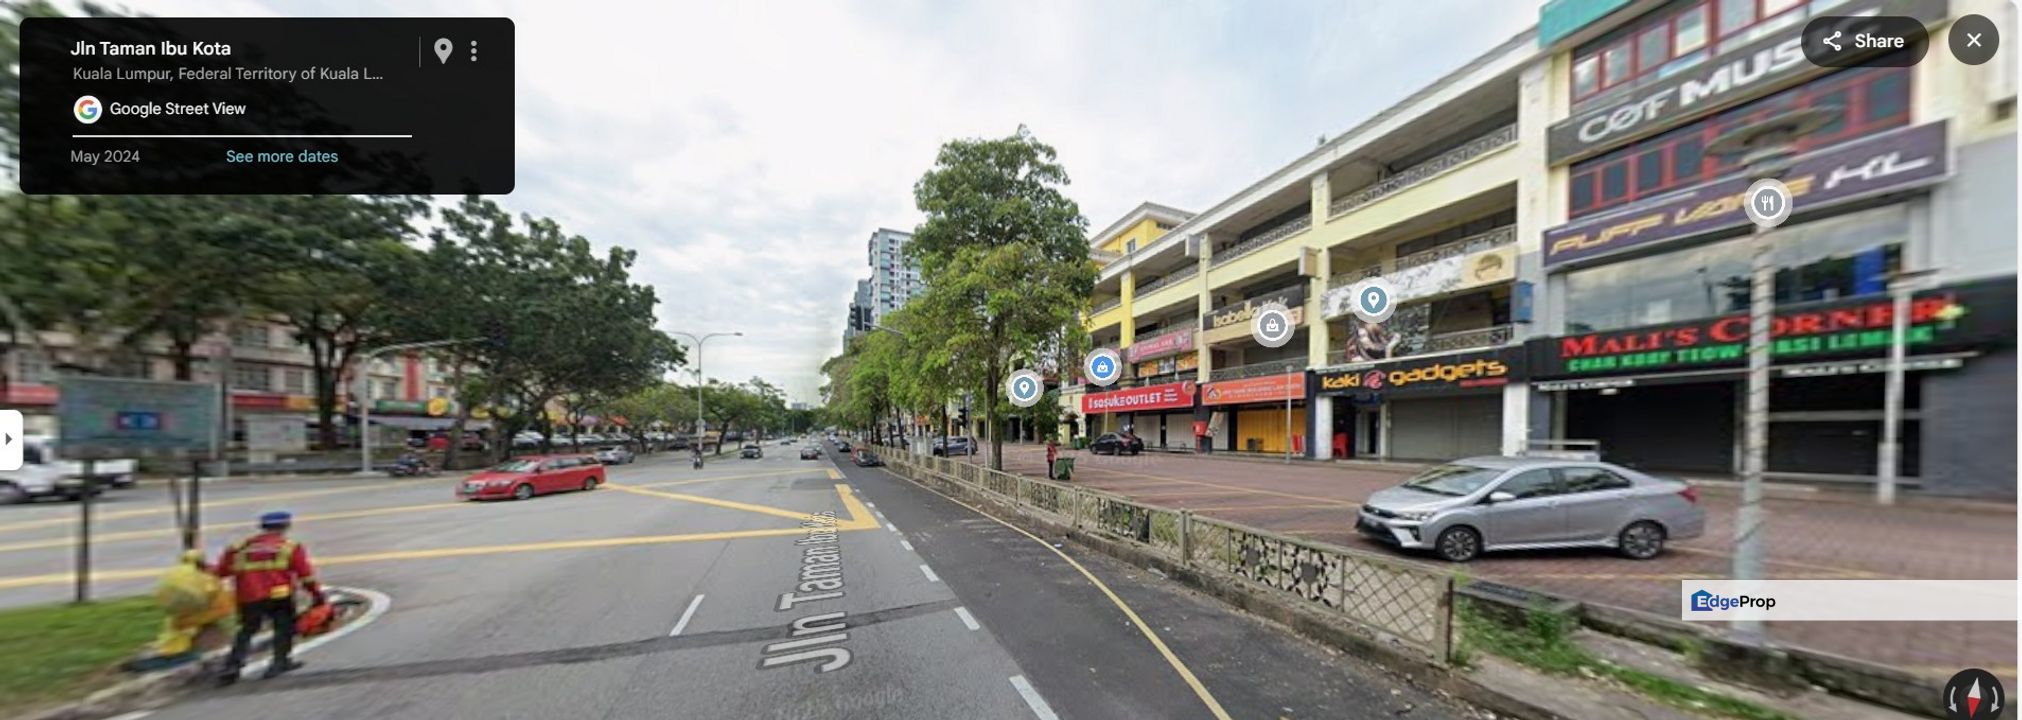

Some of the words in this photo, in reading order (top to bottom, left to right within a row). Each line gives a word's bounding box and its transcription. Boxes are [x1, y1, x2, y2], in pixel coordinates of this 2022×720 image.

[1549, 213, 1664, 256] PUFF
[1388, 358, 1508, 387] gadgets
[1126, 391, 1162, 406] OUTLET
